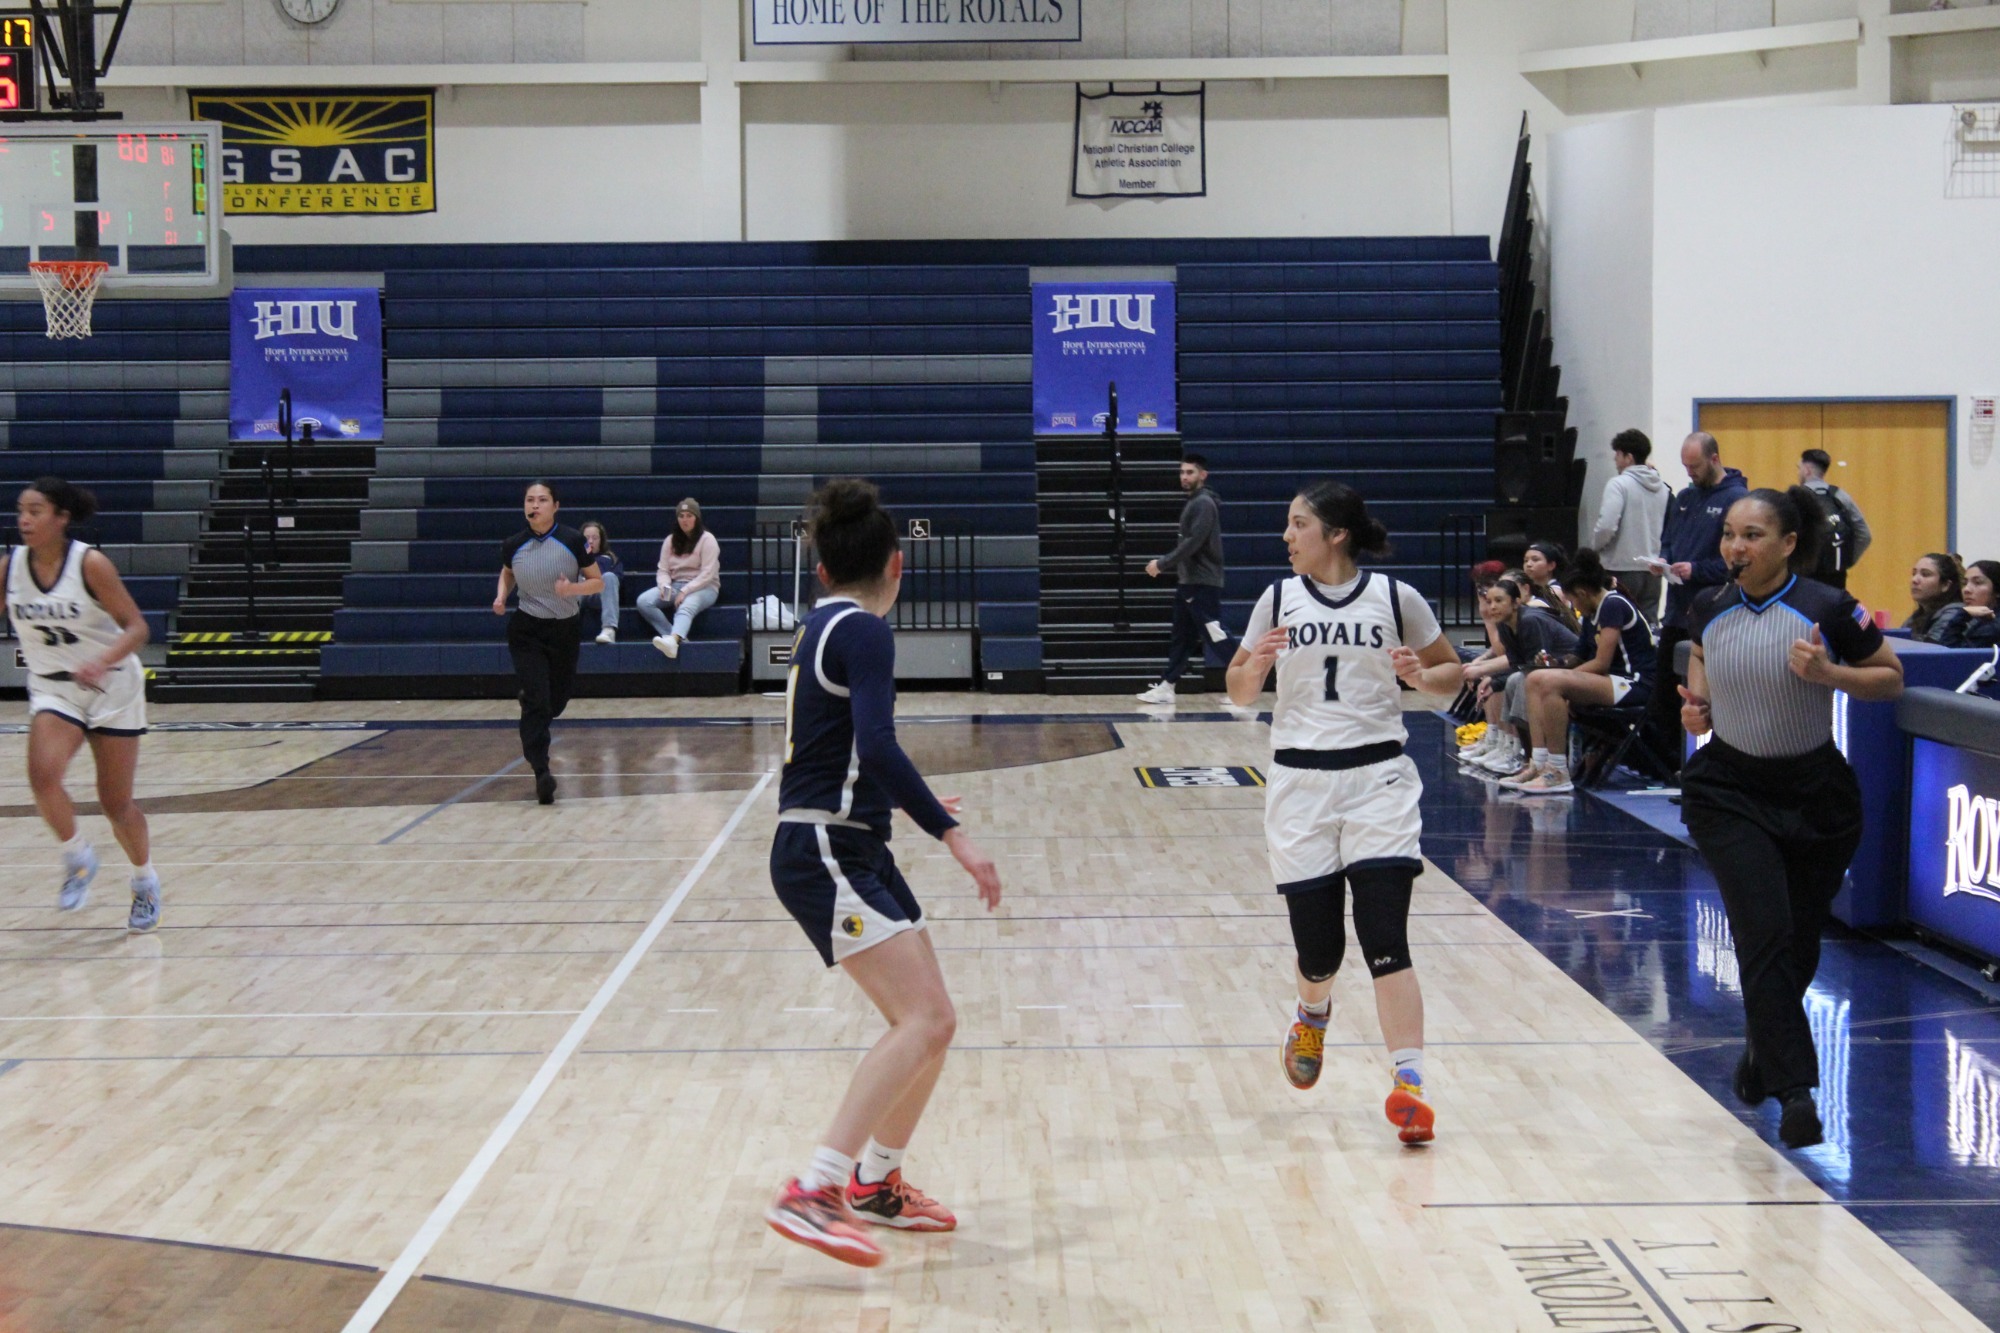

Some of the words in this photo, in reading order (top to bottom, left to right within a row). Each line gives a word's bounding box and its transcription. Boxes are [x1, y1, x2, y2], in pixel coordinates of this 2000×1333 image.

[771, 0, 846, 25] HOME
[1110, 120, 1163, 133] NCCAA
[1083, 144, 1115, 155] National
[1118, 143, 1158, 153] Christian
[1161, 143, 1195, 155] College
[1094, 158, 1126, 168] Athletic
[1128, 157, 1182, 168] Association
[1118, 178, 1157, 189] Member
[232, 195, 421, 208] ONFERENCE
[248, 300, 359, 341] HIU
[1047, 294, 1156, 335] HIU
[1288, 621, 1384, 649] ROYALS
[1323, 655, 1340, 702] 1
